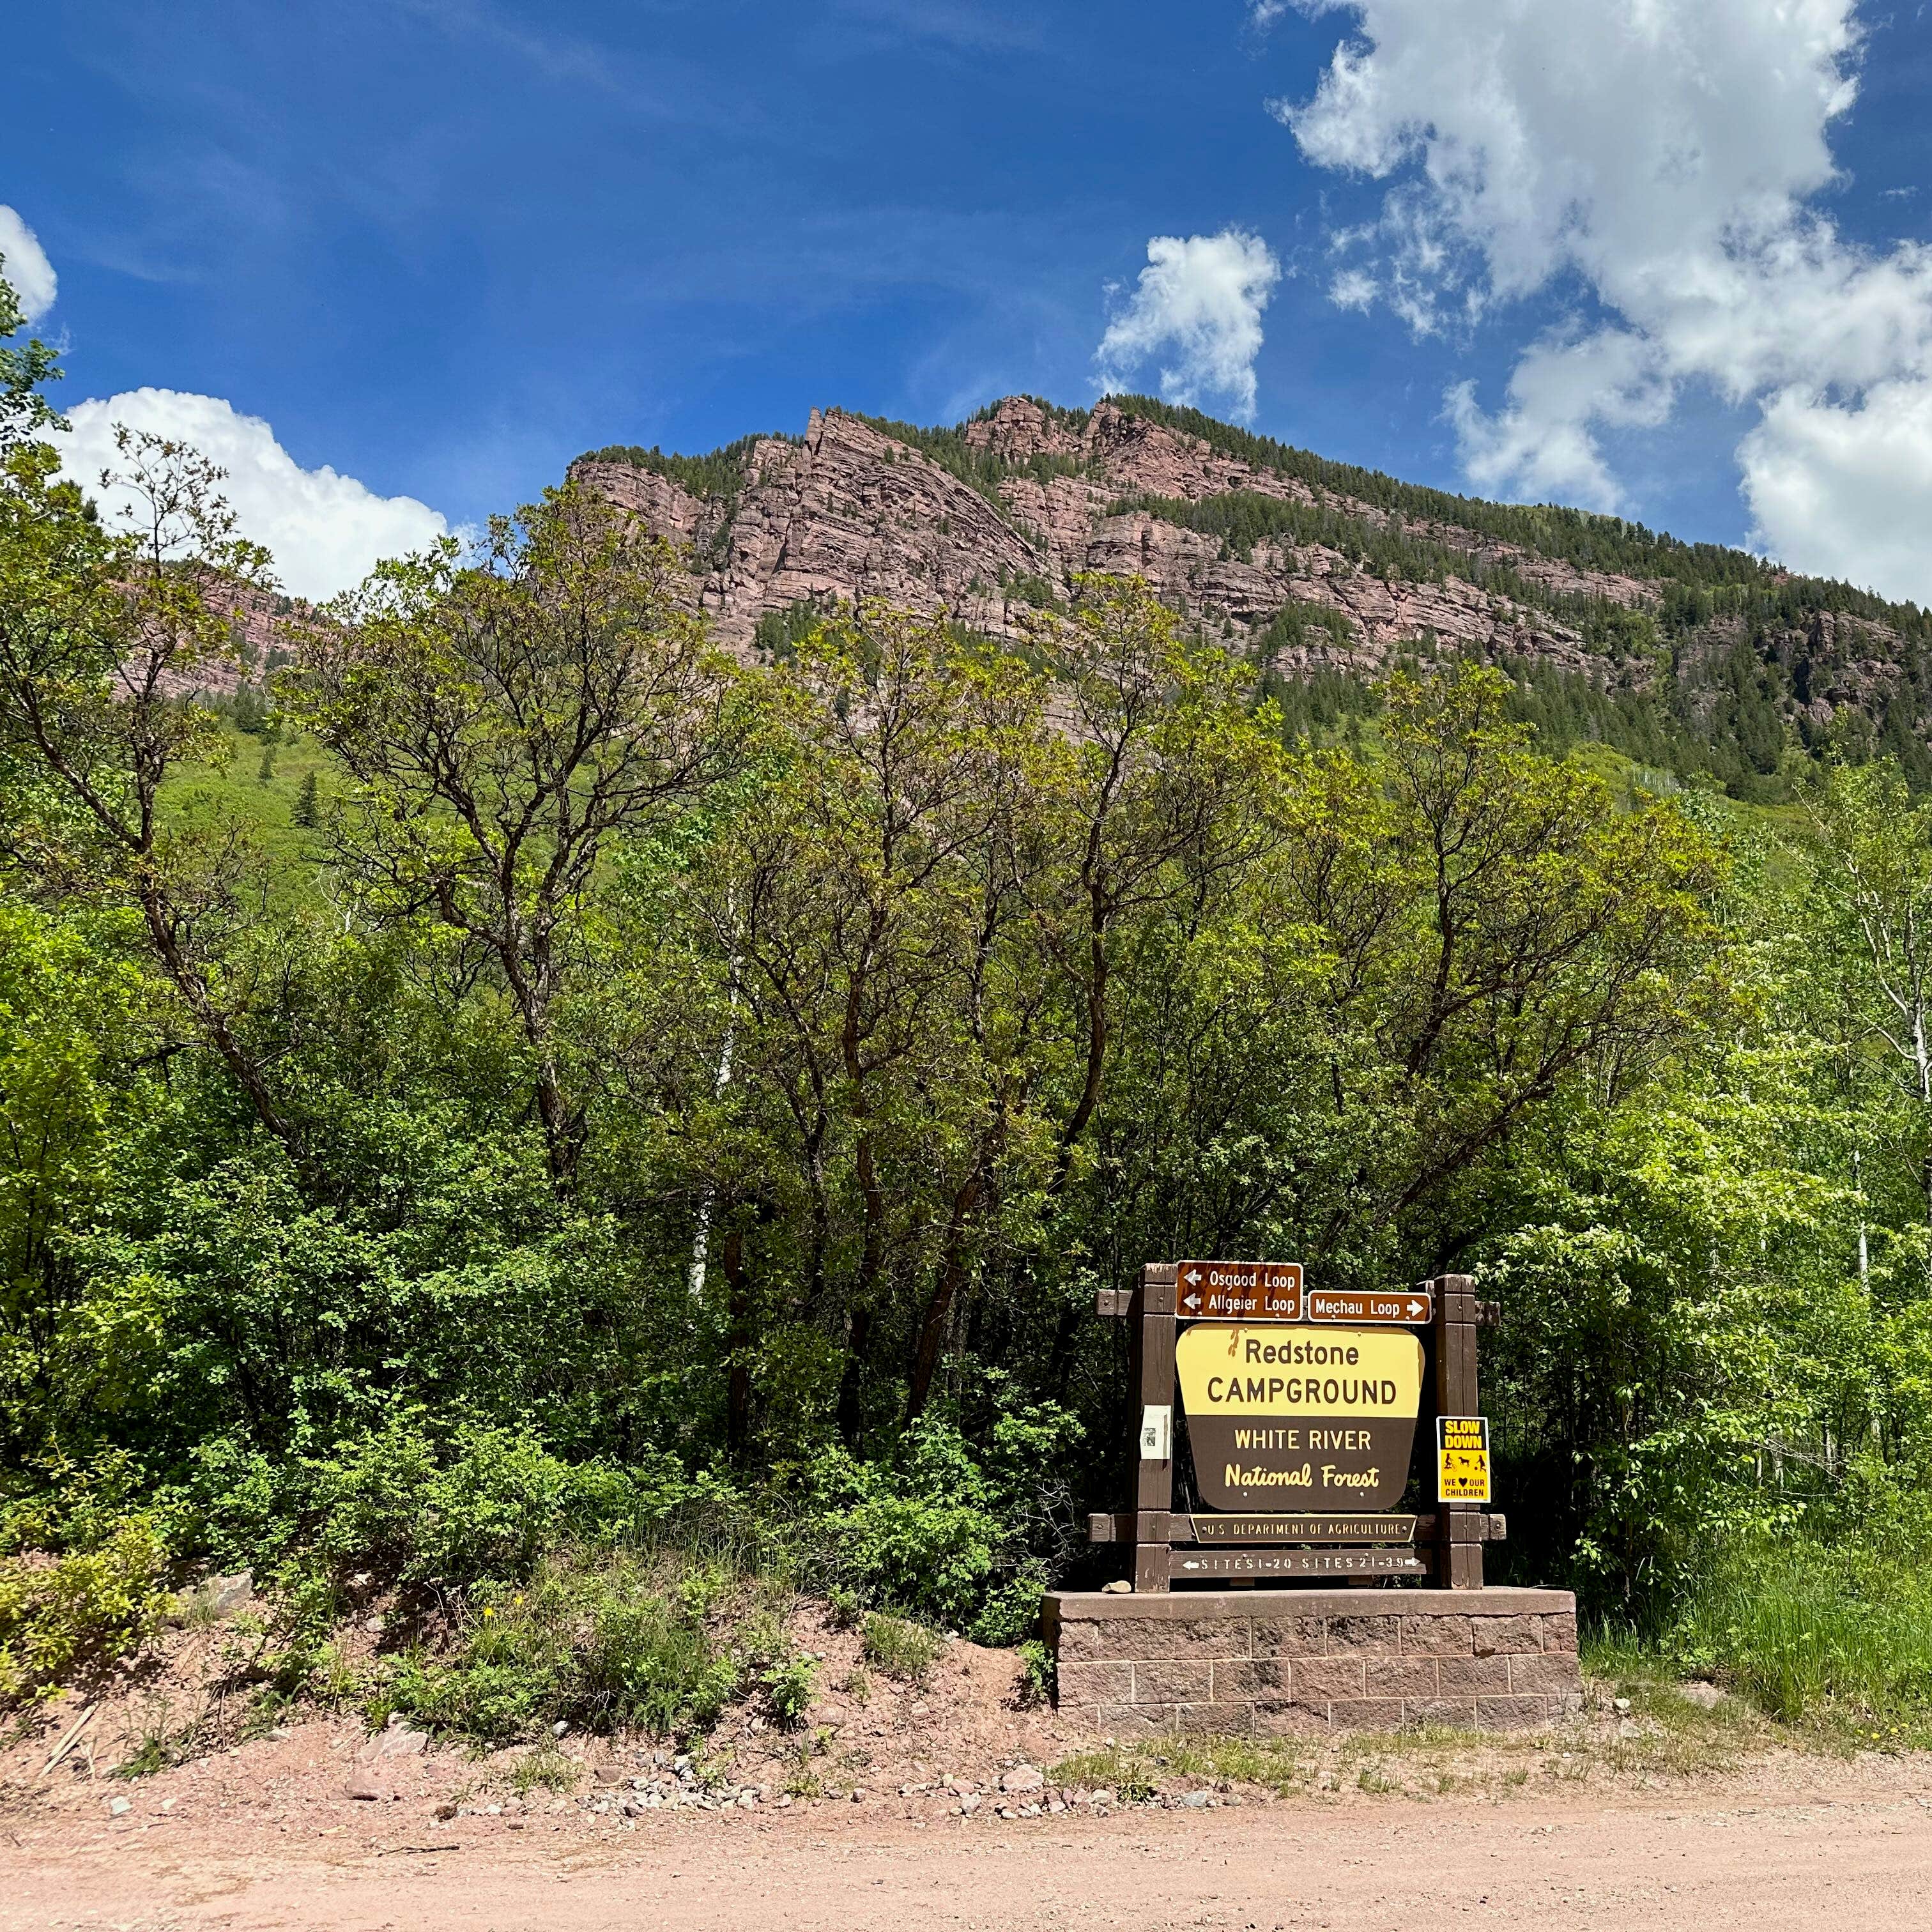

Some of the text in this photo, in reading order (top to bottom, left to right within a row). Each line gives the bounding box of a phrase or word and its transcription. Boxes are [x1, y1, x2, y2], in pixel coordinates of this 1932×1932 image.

[1209, 1271, 1296, 1291] Osgood Loop
[1208, 1294, 1295, 1315] Allgeier Loop
[1315, 1298, 1400, 1318] Mechau Loop
[1246, 1338, 1359, 1365] Redstone
[1208, 1377, 1397, 1405] CAMPGROUND
[1445, 1420, 1480, 1434] SLOW
[1234, 1429, 1371, 1450] WHITE RIVER
[1445, 1435, 1482, 1449] DOWN
[1225, 1462, 1380, 1487] National Forest
[1233, 1523, 1304, 1535] DEPARTMENT
[1310, 1523, 1322, 1535] OF
[1328, 1523, 1401, 1535] AGRICULTURE
[1301, 1558, 1353, 1569] SITES
